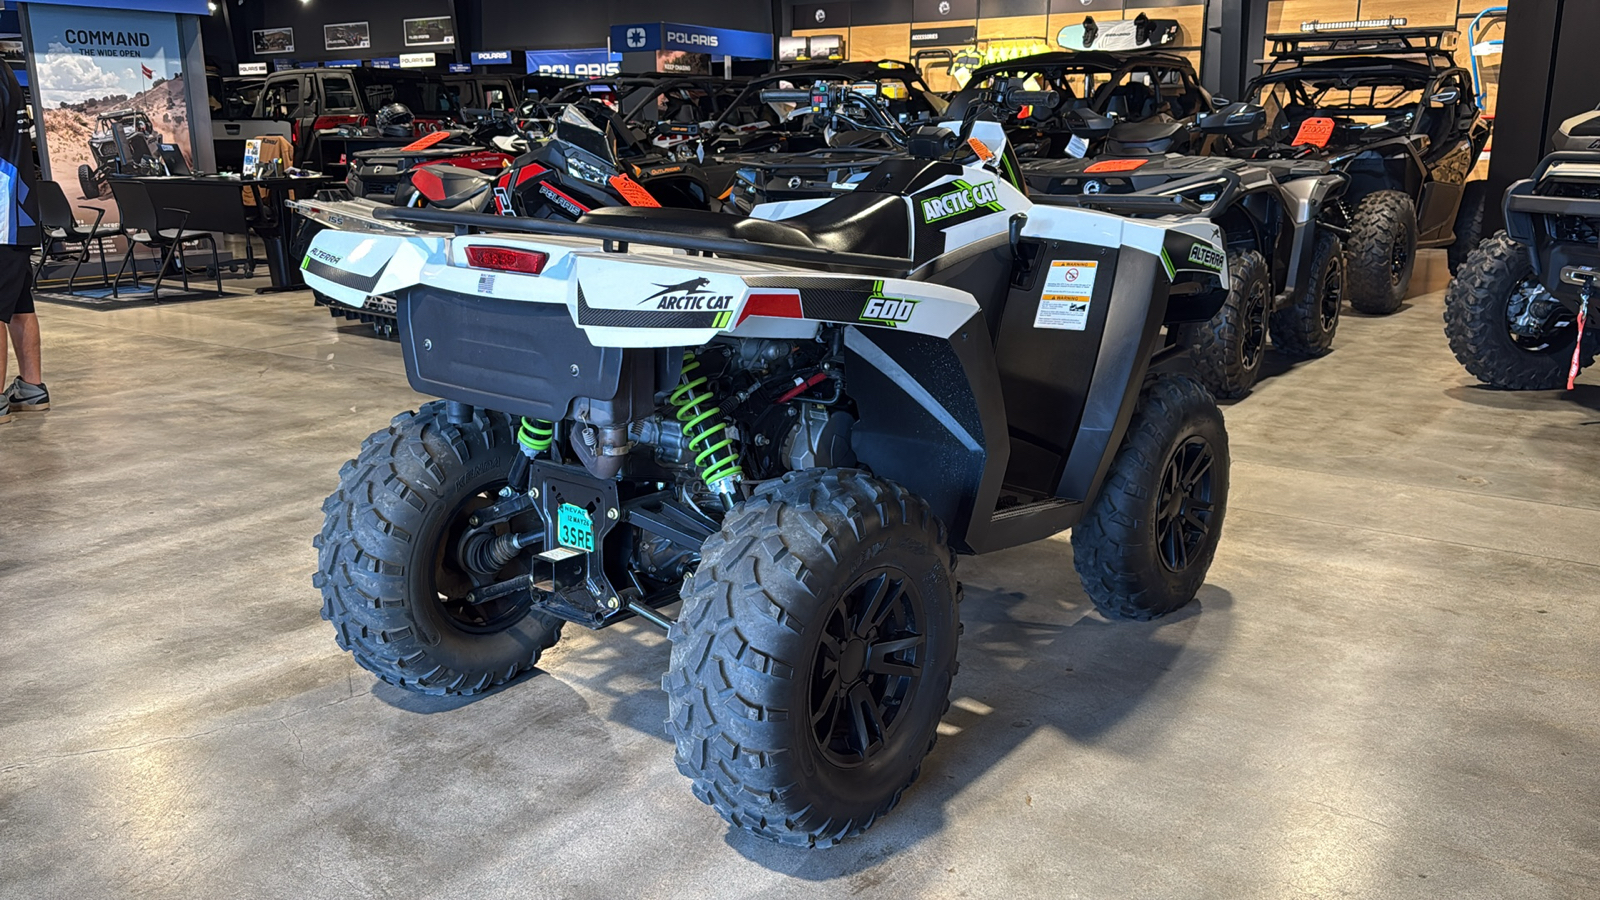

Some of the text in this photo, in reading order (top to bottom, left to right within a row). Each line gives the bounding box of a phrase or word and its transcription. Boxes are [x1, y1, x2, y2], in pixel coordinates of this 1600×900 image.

[65, 29, 150, 47] COMMAND
[667, 31, 719, 47] POLARIS
[79, 48, 95, 56] THE
[97, 49, 118, 57] WIDE
[478, 52, 508, 60] POLARIS
[539, 185, 582, 217] POLARIS
[922, 182, 998, 222] ARCTIC CAT
[310, 246, 341, 265] ALTERRA
[1190, 245, 1224, 269] ALTERRA
[656, 295, 734, 310] ARCTIC CAT
[861, 298, 916, 320] 600
[562, 524, 592, 551] 3SRE
